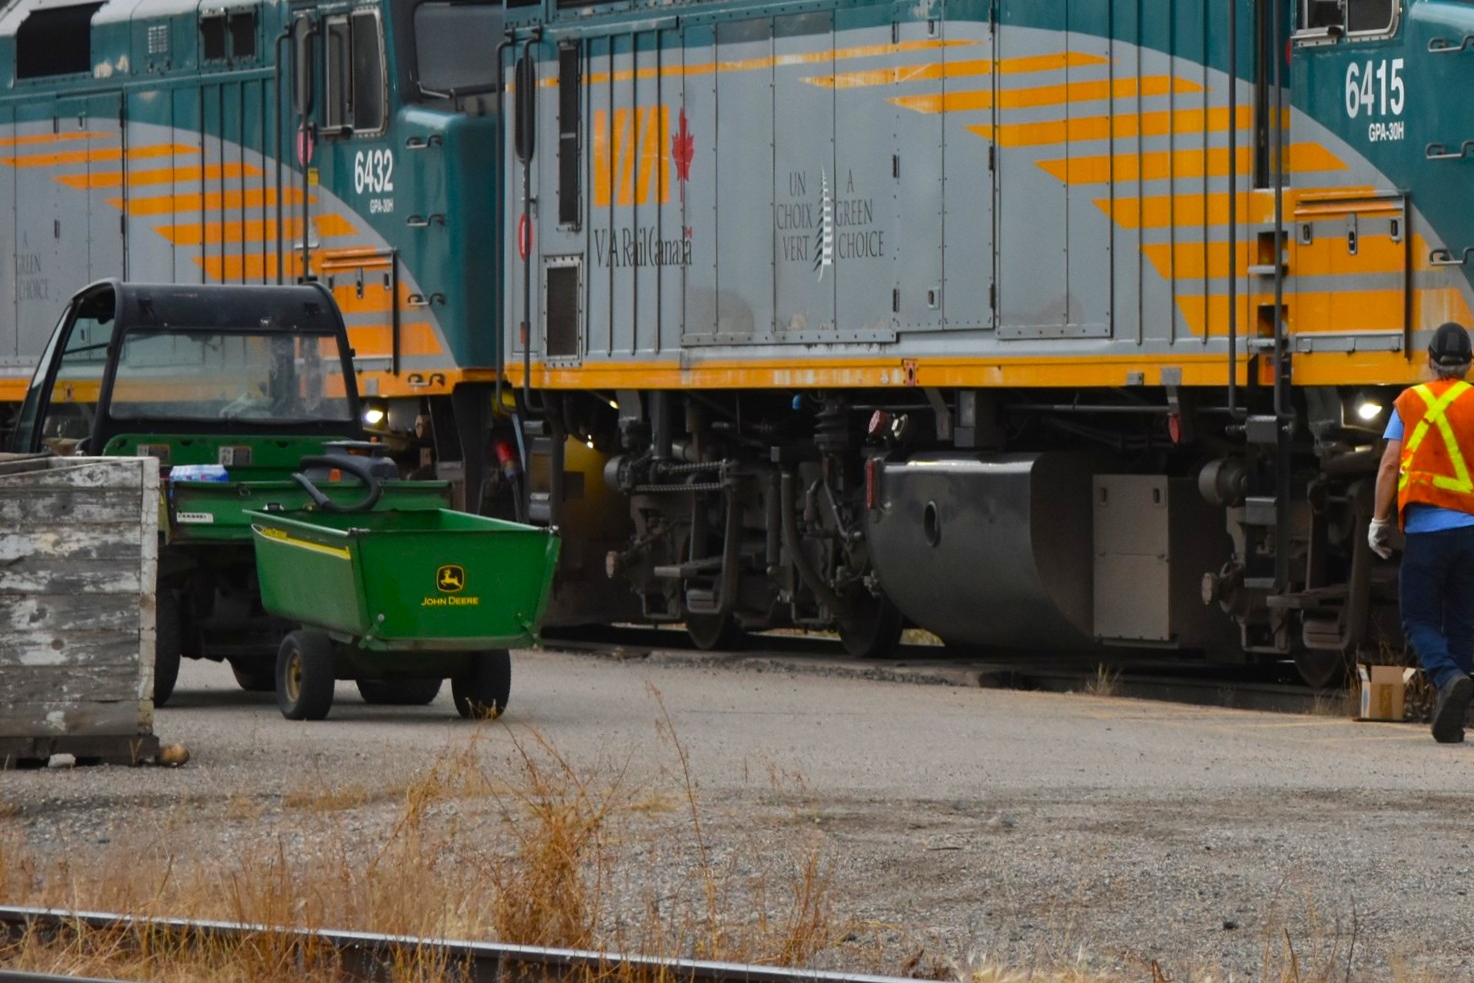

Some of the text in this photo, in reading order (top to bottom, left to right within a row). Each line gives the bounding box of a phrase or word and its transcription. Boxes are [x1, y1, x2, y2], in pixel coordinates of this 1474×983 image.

[1345, 58, 1405, 119] 6415
[1368, 121, 1405, 142] GPA-30H
[593, 105, 671, 207] VIA
[354, 148, 394, 195] 6432
[789, 170, 806, 197] UN
[846, 168, 855, 194] A
[775, 203, 813, 229] CHOIX
[835, 198, 873, 227] GREEN
[594, 227, 620, 267] VA
[783, 235, 810, 261] VERT
[838, 230, 885, 259] CHOICE
[421, 596, 479, 606] JOHN DEERE
